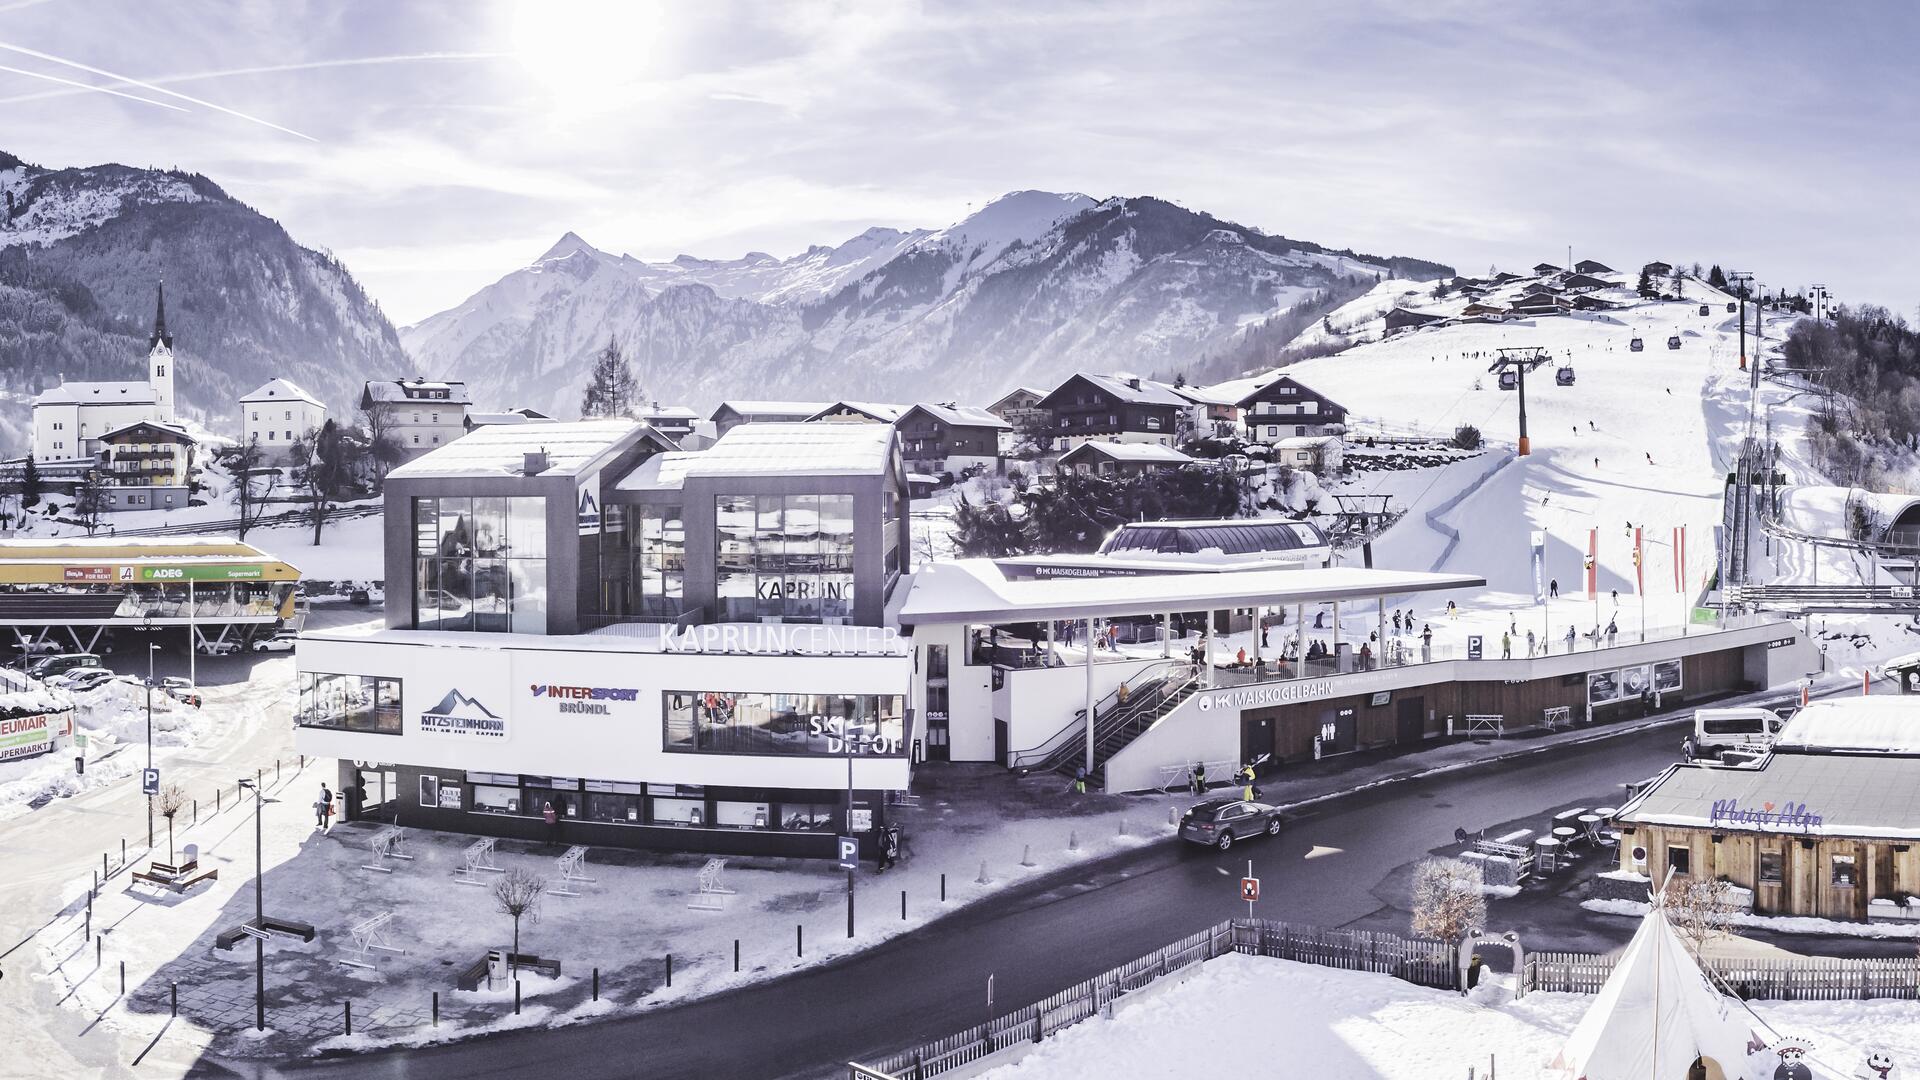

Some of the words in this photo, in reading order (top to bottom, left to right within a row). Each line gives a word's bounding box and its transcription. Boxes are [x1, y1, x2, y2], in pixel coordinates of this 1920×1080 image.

[153, 569, 184, 578] ADEG
[1051, 568, 1099, 577] MAISKOGELBAHN
[1469, 637, 1480, 651] P
[548, 685, 639, 701] INTERSPORT
[1234, 682, 1333, 706] MAISKOGELBAHN
[559, 701, 611, 715] BRÜNDL
[0, 716, 47, 736] EUMAIR
[421, 715, 504, 731] KITZSTEINHORN
[810, 715, 845, 736] SKI
[828, 734, 902, 754] DEPOT
[145, 771, 158, 787] P
[841, 841, 857, 860] P
